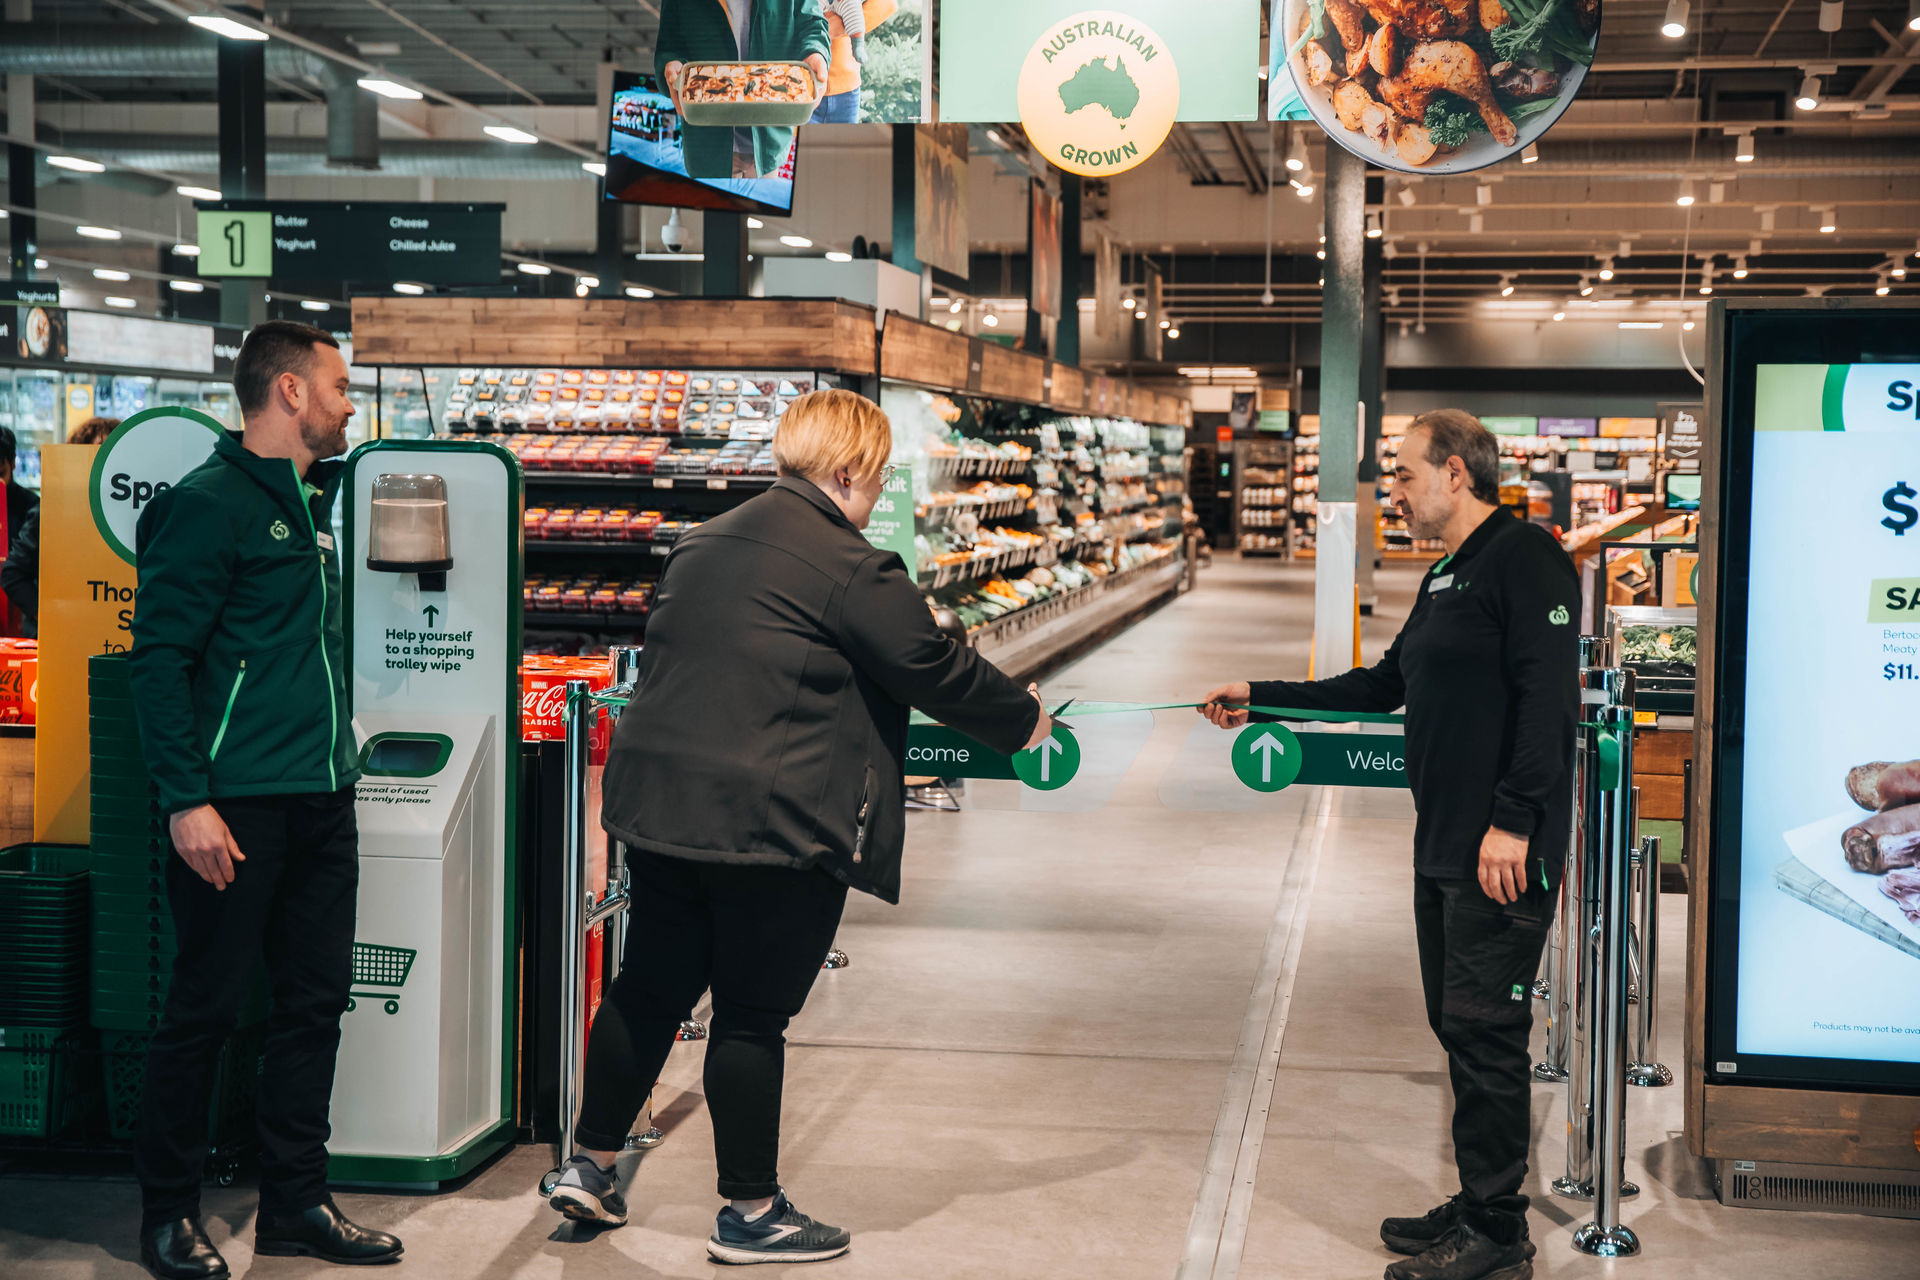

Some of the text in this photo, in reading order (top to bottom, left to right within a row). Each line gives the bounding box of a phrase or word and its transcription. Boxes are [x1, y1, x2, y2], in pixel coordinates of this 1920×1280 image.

[1042, 21, 1158, 63] AUSTRALIAN
[1060, 141, 1138, 166] GROWN
[275, 215, 308, 228] Butter
[389, 216, 429, 229] Cheese
[224, 220, 244, 267] 1
[275, 238, 317, 252] Yoghurt
[389, 239, 456, 252] Chilled Juice
[884, 475, 907, 493] uit
[873, 495, 895, 512] ds
[385, 629, 472, 643] Help yourself
[385, 644, 474, 660] to a shopping
[1883, 644, 1917, 655] Meaty
[385, 658, 461, 673] trolley wipe
[523, 719, 557, 727] LASSIC
[905, 747, 970, 762] come
[371, 796, 394, 804] only
[1813, 1021, 1851, 1031] Products
[1853, 1025, 1872, 1034] may
[1891, 1026, 1902, 1034] be
